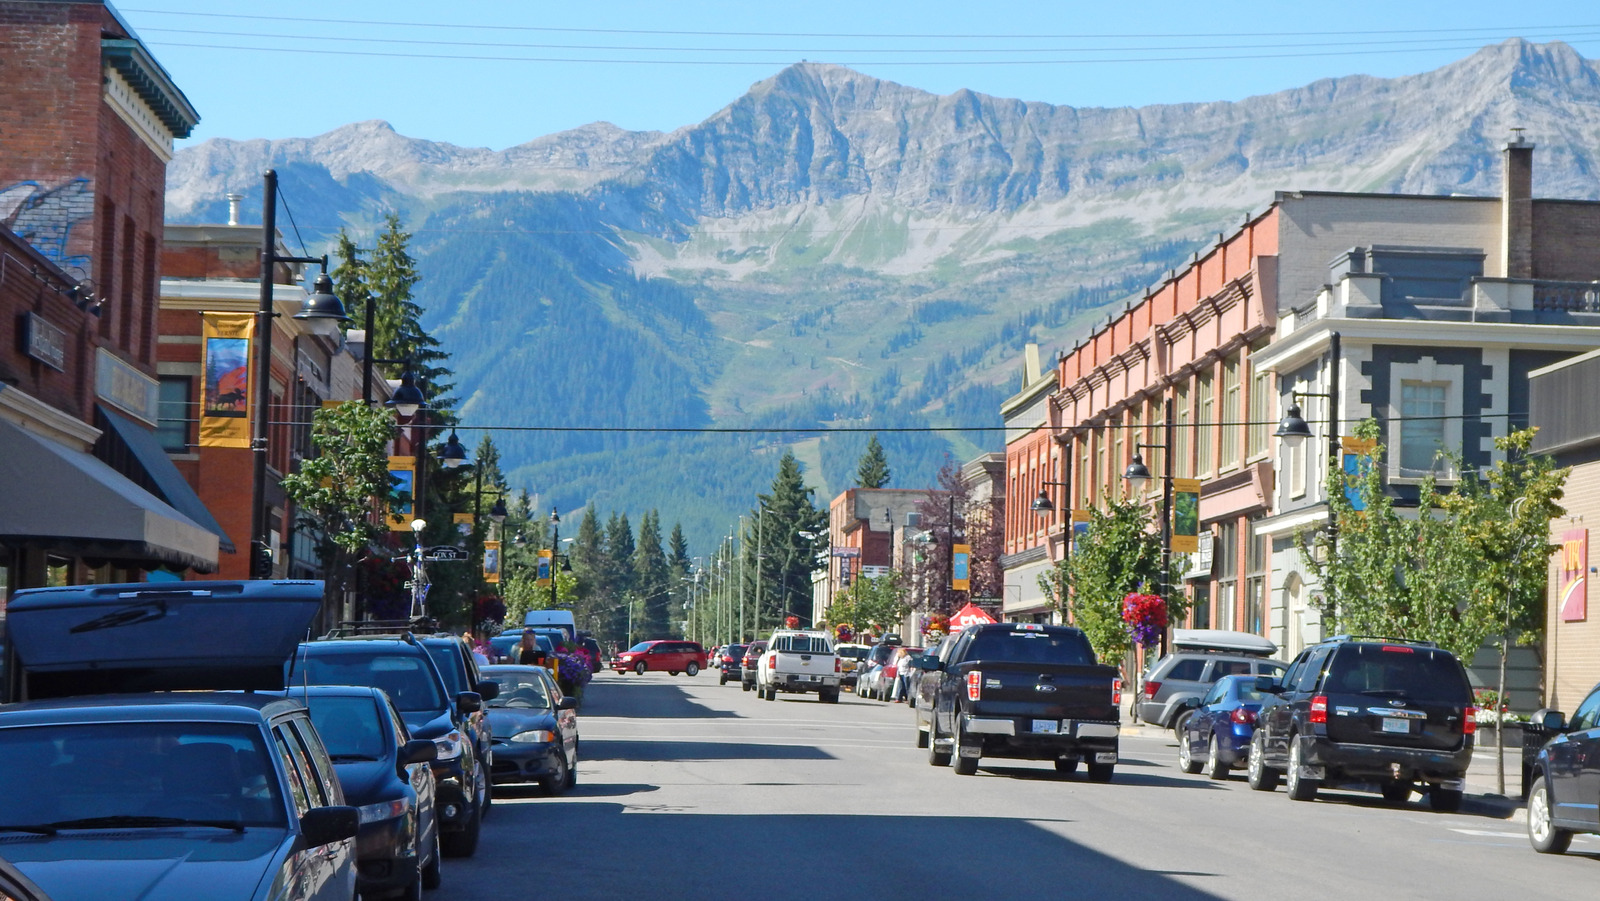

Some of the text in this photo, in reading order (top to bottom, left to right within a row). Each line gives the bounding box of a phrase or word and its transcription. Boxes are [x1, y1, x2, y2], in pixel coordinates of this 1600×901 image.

[433, 551, 457, 559] COX ST
[1563, 540, 1583, 571] CIBC
